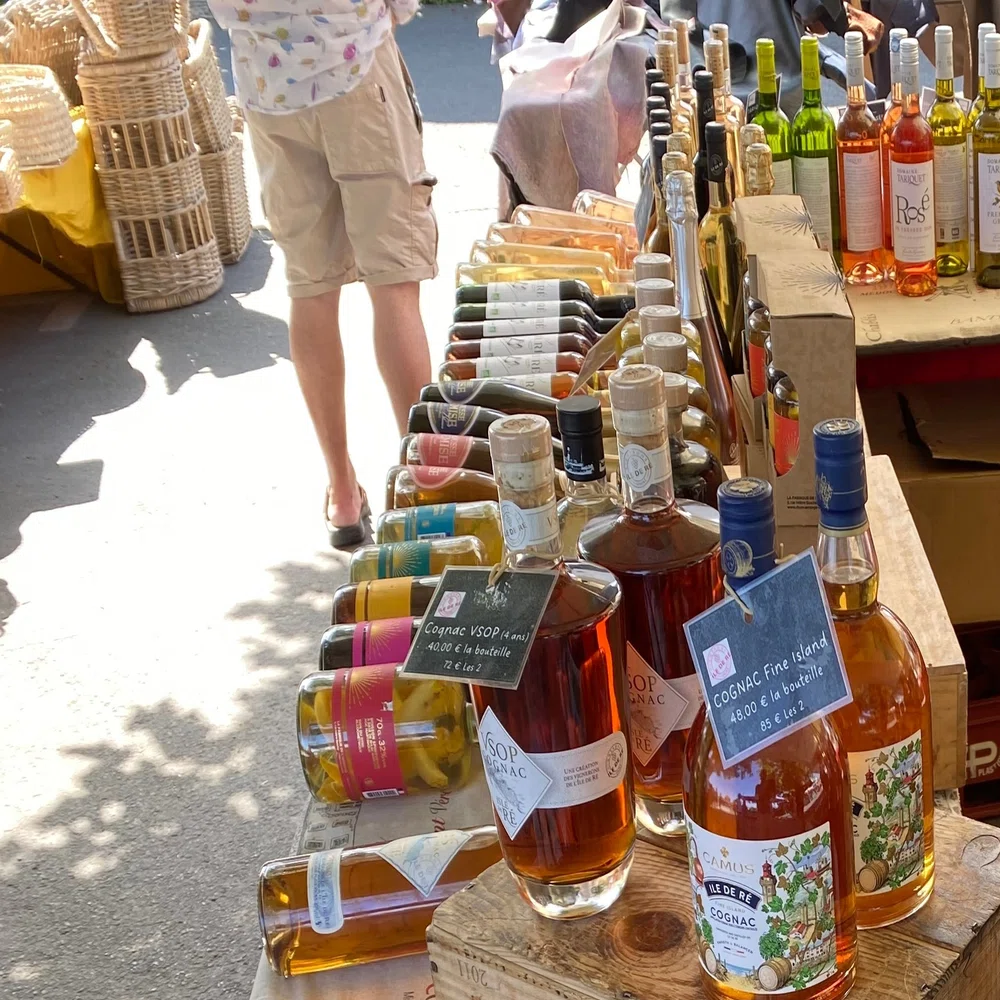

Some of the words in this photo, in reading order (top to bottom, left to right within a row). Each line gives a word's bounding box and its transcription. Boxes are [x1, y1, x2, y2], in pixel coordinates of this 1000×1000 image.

[897, 173, 926, 186] TARIQUET
[895, 188, 930, 225] Rosé
[424, 621, 466, 639] Cognac
[470, 625, 500, 639] VSOP
[500, 630, 510, 640] (4
[511, 632, 530, 643] ans)
[427, 641, 453, 653] 40,00
[454, 643, 462, 653] €
[463, 644, 472, 655] la
[474, 646, 511, 658] bouteille
[443, 660, 453, 670] 72
[454, 661, 462, 670] €
[462, 662, 475, 672] Les
[475, 663, 482, 672] 2
[713, 671, 762, 708] COGNAC
[763, 659, 790, 681] Fine
[791, 631, 829, 663] Island
[730, 701, 757, 724] 48,00
[760, 695, 769, 708] €
[769, 689, 781, 702] la
[782, 665, 824, 695] bouteille
[760, 719, 772, 732] 85
[774, 713, 782, 723] €
[783, 706, 797, 720] Les
[798, 700, 805, 712] 2
[481, 731, 518, 763] VSOP
[702, 851, 755, 875] CAMUS
[709, 884, 722, 894] ILE
[723, 885, 736, 897] DE
[739, 888, 753, 903] RÉ
[710, 906, 756, 927] COGNAC
[458, 959, 488, 987] 2011
